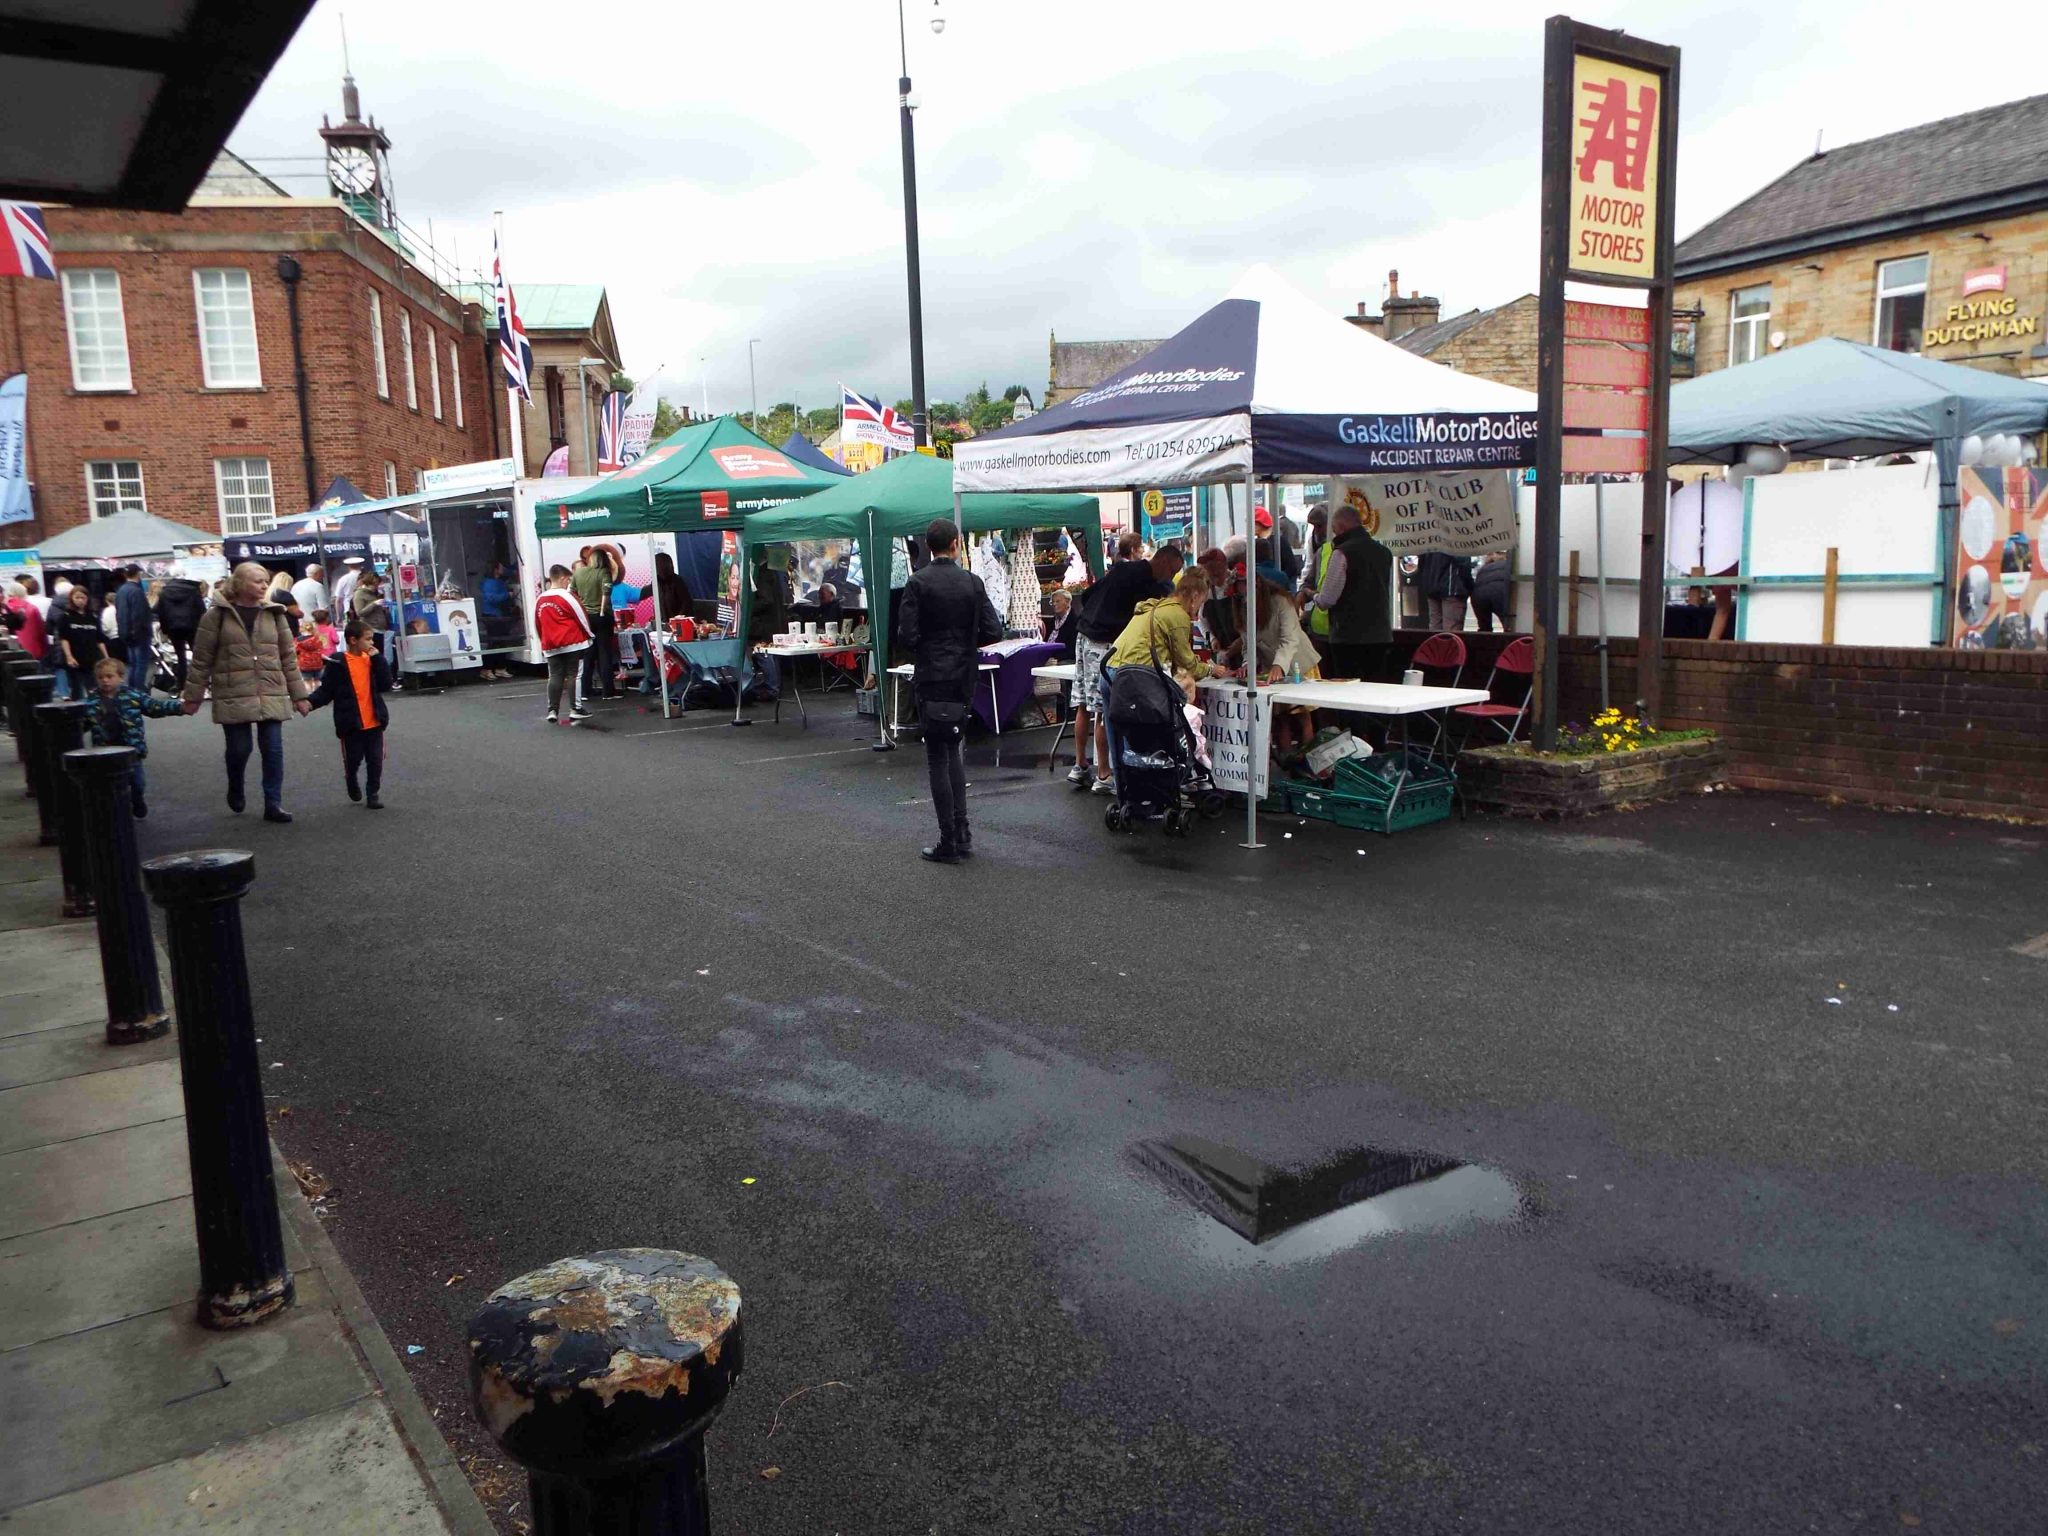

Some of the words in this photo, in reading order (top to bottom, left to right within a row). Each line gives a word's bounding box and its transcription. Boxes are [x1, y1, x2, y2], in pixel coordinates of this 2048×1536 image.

[1580, 194, 1645, 229] MOTOR
[1578, 230, 1645, 263] STORES
[1626, 310, 1646, 323] BOX
[1946, 298, 2016, 322] FLYING
[1564, 321, 1586, 337] IRE
[1609, 325, 1645, 340] SALES
[1925, 317, 2038, 347] DUTCHMAN
[1156, 383, 1205, 394] CENTRE
[960, 448, 1111, 473] www.gaskellmotorbodies.com
[1125, 443, 1145, 460] Tel:
[1146, 439, 1184, 459] 01254
[1186, 434, 1236, 456] 829524
[1370, 450, 1433, 467] ACCIDENT
[1435, 448, 1476, 464] REPAIR
[1477, 446, 1522, 462] CENTRE
[1384, 478, 1432, 499] ROTA
[1439, 477, 1484, 502] CLUB
[1148, 499, 1158, 511] £1
[1396, 502, 1420, 518] OF
[1395, 519, 1442, 533] DISTRIC
[1454, 525, 1474, 537] NO.
[1475, 518, 1494, 532] 607
[275, 543, 317, 555] (Burnley)
[318, 542, 365, 553] quadron
[422, 603, 435, 614] NHS
[1216, 700, 1260, 722] CLU
[1201, 724, 1249, 747] DIHAM
[1220, 750, 1238, 763] NO.
